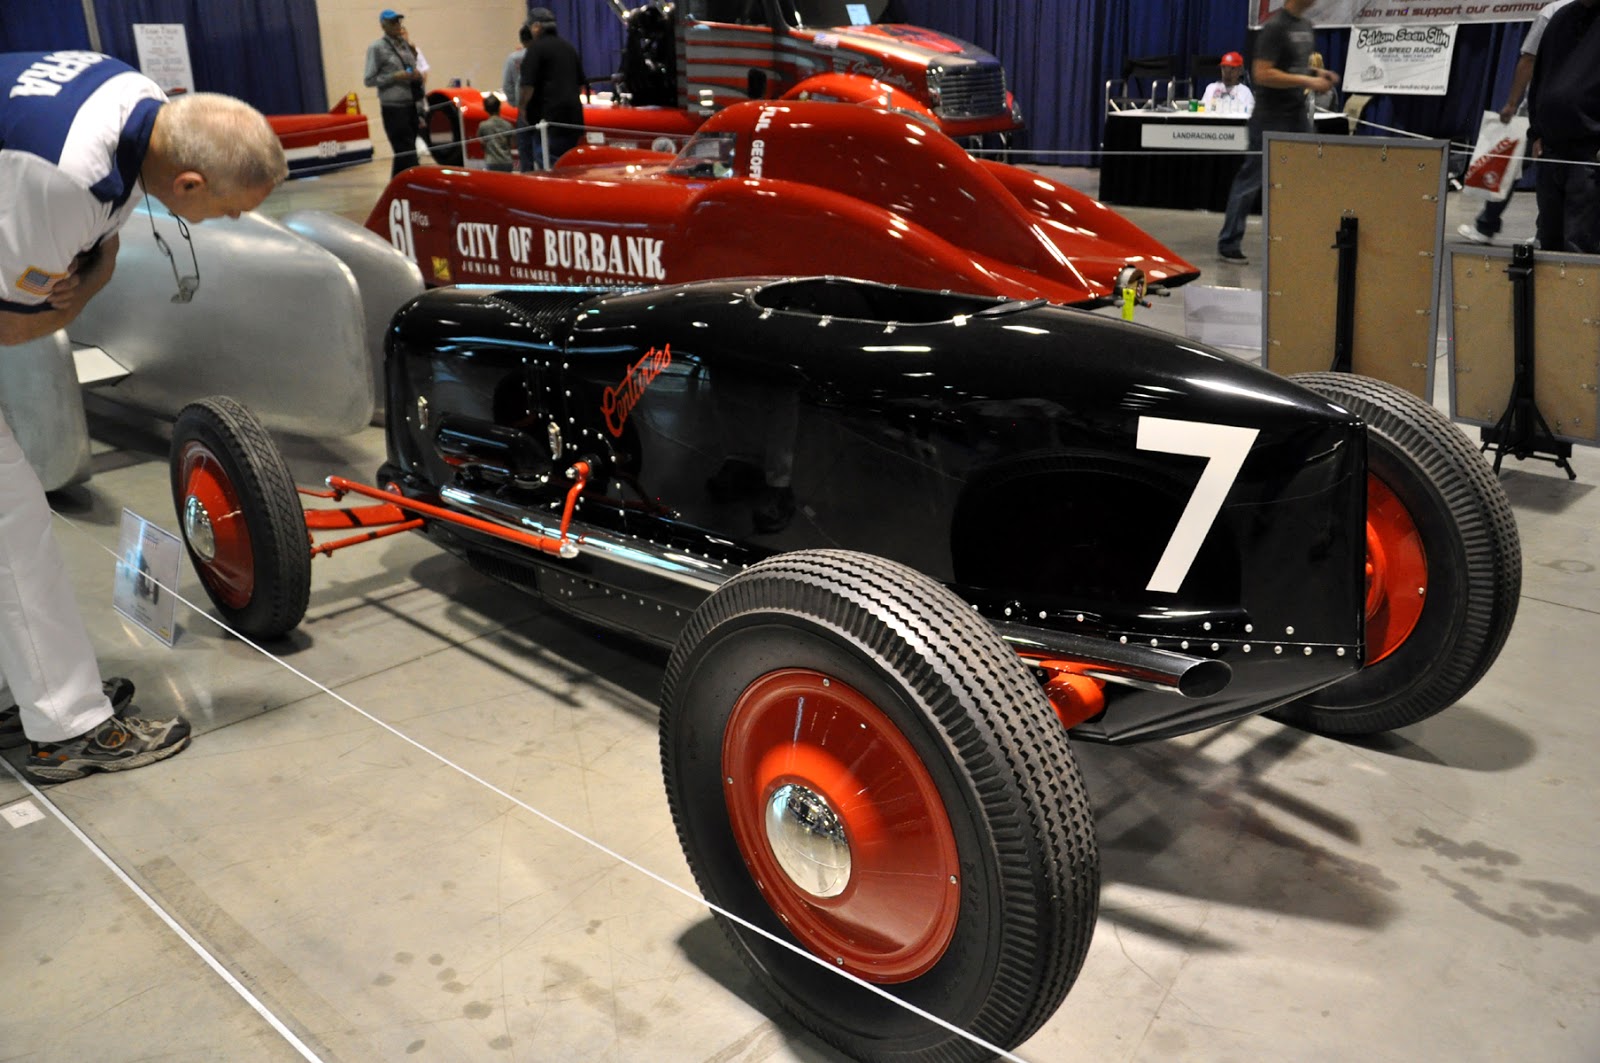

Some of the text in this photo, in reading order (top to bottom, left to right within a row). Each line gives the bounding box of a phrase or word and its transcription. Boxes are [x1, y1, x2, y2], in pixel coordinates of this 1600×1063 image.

[1386, 7, 1408, 16] and
[1412, 6, 1461, 17] support
[1467, 4, 1489, 14] our
[1357, 27, 1450, 48] Seldom Seen Slim
[1172, 131, 1235, 141] LANDRACING.COM
[389, 198, 417, 264] 61
[456, 222, 666, 280] CITY OF BURBANK
[462, 260, 500, 276] JUNIOR
[510, 266, 557, 283] CHAMBER
[600, 343, 671, 437] Centuries
[1136, 416, 1260, 593] 7
